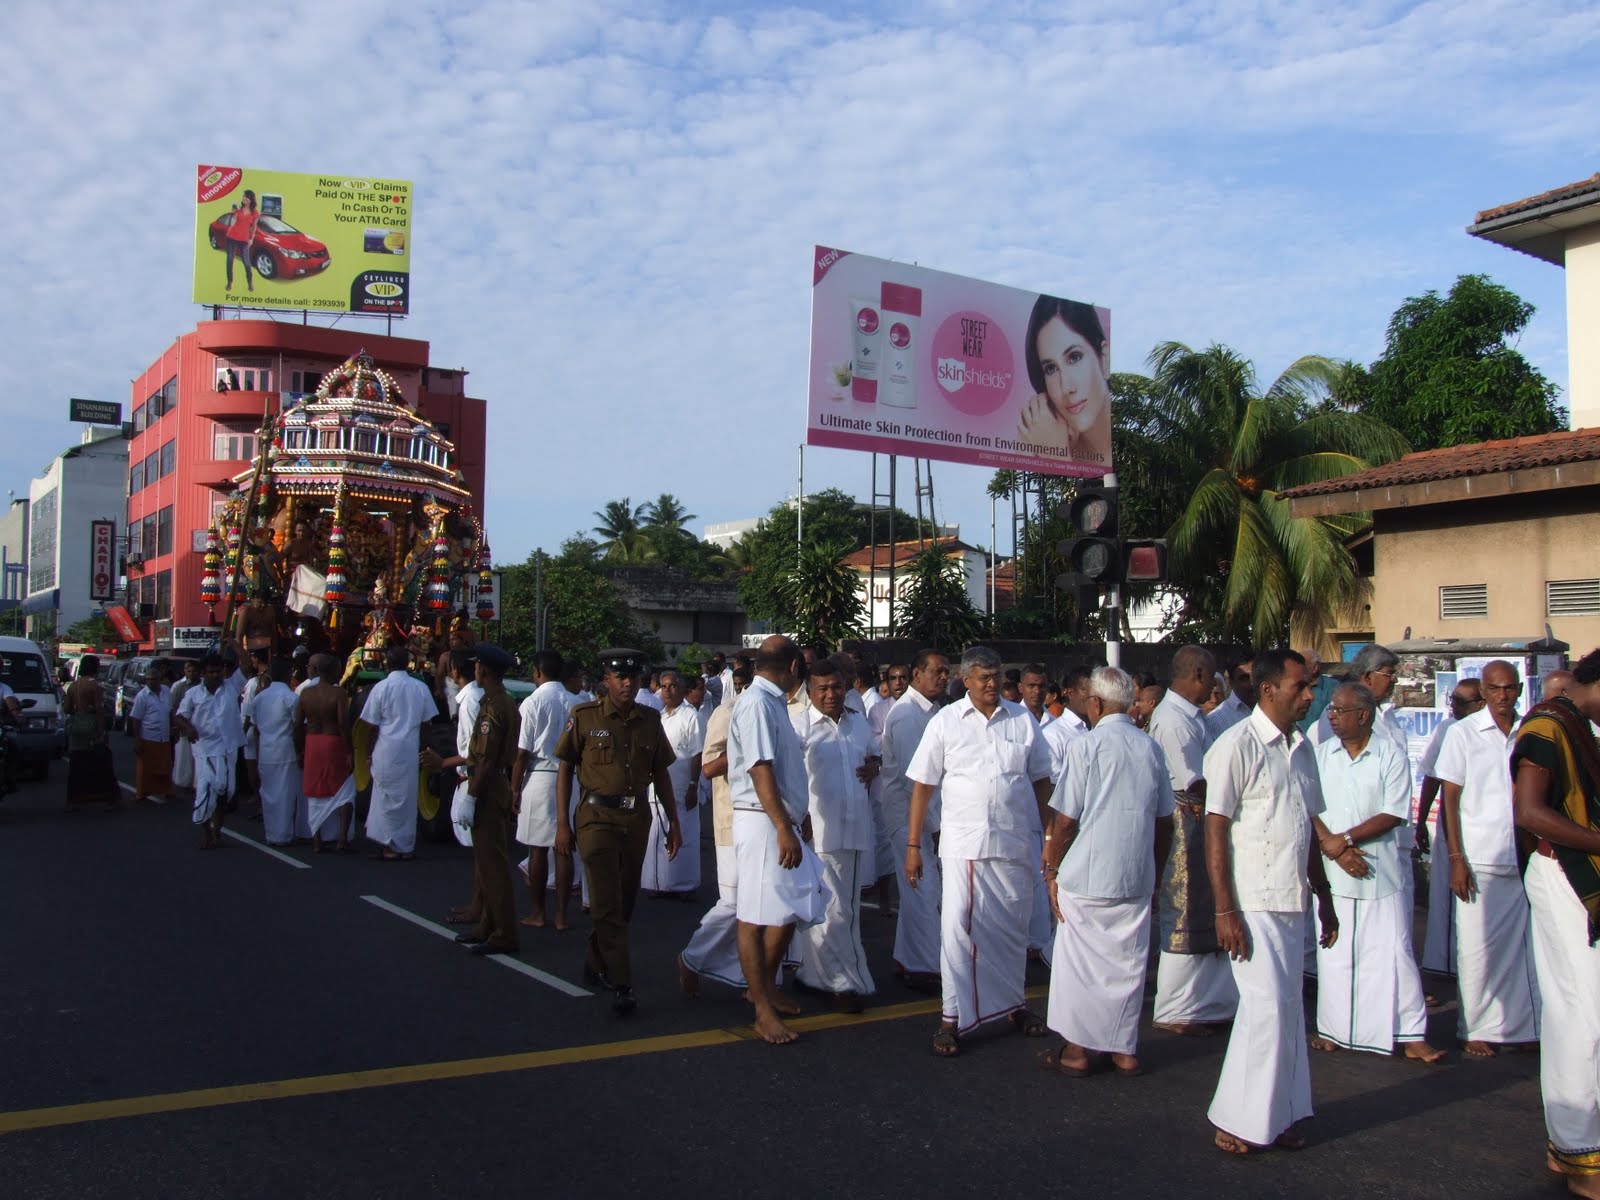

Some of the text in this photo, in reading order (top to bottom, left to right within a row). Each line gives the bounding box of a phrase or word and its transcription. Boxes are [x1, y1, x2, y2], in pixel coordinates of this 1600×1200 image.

[201, 170, 240, 201] Innovation
[319, 178, 408, 192] Now VIP Claims
[315, 189, 337, 199] Paid
[340, 191, 354, 200] ON
[357, 193, 376, 202] THE
[342, 203, 407, 215] In Cash Or To
[334, 213, 406, 227] Your ATM Card
[818, 249, 839, 270] NEW
[364, 275, 405, 283] CEYLINCO
[374, 284, 395, 295] VIP
[225, 294, 239, 302] For
[241, 295, 263, 303] more
[264, 297, 291, 305] details
[313, 299, 346, 308] 2393939
[960, 318, 987, 340] STREET
[963, 338, 983, 358] WEAR
[76, 402, 117, 413] SENANAYAKE
[80, 410, 112, 420] BUILDING
[820, 413, 1105, 463] Ultimate Skin Protection from Environmental factors
[95, 527, 109, 595] CHARIOT
